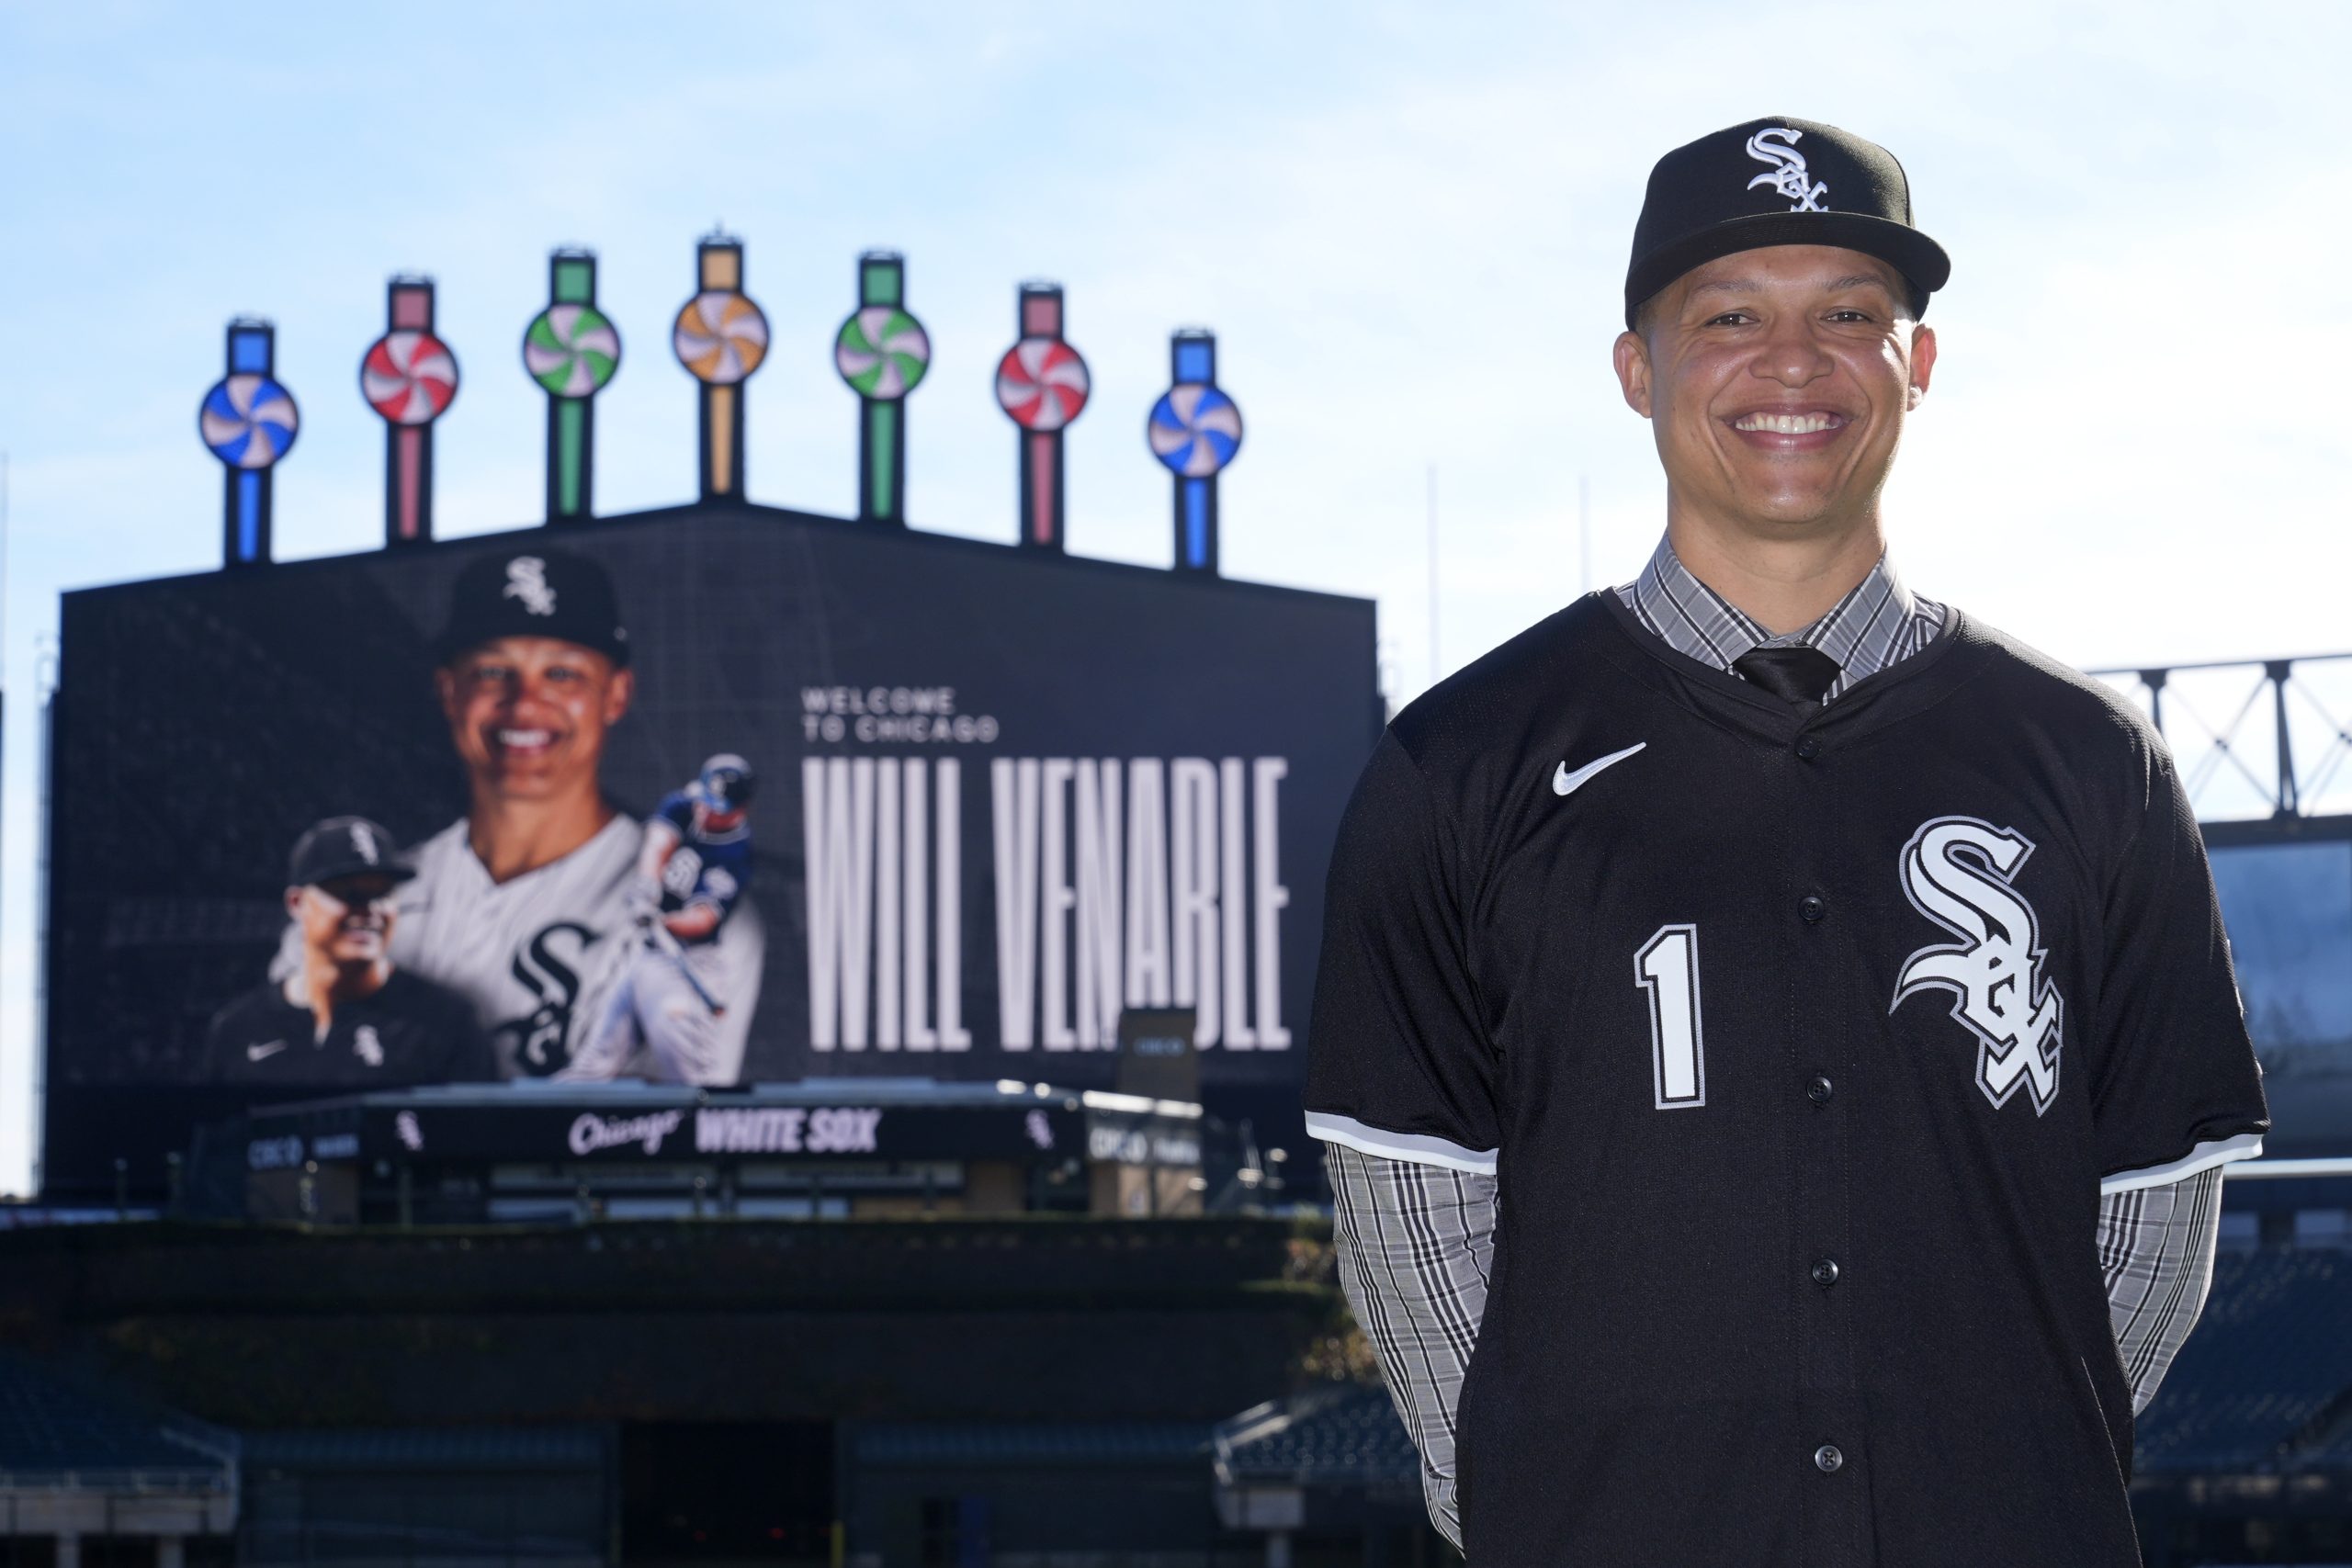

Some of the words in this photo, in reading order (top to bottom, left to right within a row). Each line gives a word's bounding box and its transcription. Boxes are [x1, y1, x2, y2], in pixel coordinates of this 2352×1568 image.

[1746, 128, 1829, 213] Sox
[801, 715, 845, 742] TO
[854, 715, 1000, 743] CHICAGO
[802, 686, 956, 716] WELCOME
[802, 757, 972, 1052] WILL
[990, 757, 1292, 1052] VENABLE
[1889, 815, 2064, 1118] Sox
[1634, 923, 1705, 1110] 1
[568, 1110, 683, 1155] Chicago
[695, 1108, 806, 1153] WHITE
[806, 1108, 881, 1153] SOX
